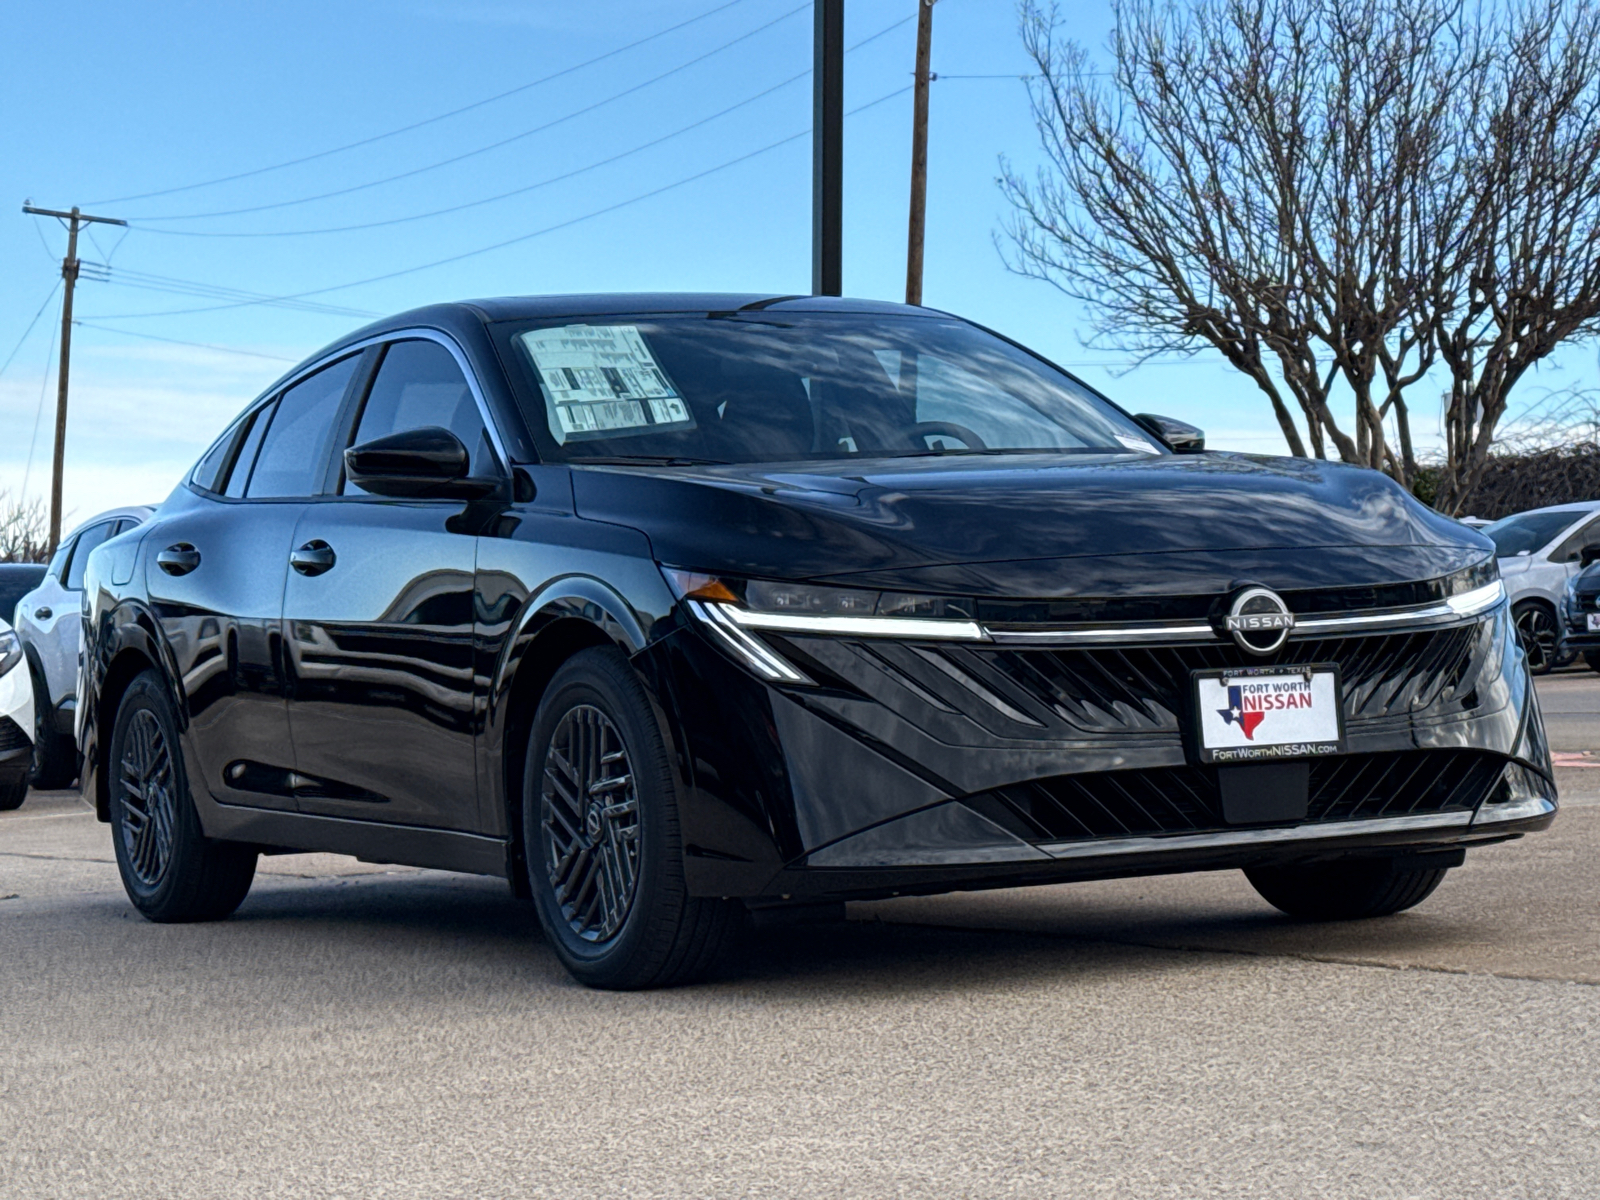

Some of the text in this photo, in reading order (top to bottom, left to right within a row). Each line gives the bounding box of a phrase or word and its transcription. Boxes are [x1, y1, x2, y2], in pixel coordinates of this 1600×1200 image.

[1228, 616, 1293, 630] NISSAN
[1223, 669, 1243, 677] FORT
[1246, 668, 1275, 676] WORTH
[1242, 681, 1311, 694] FORT WORTH
[1243, 692, 1313, 711] NISSAN
